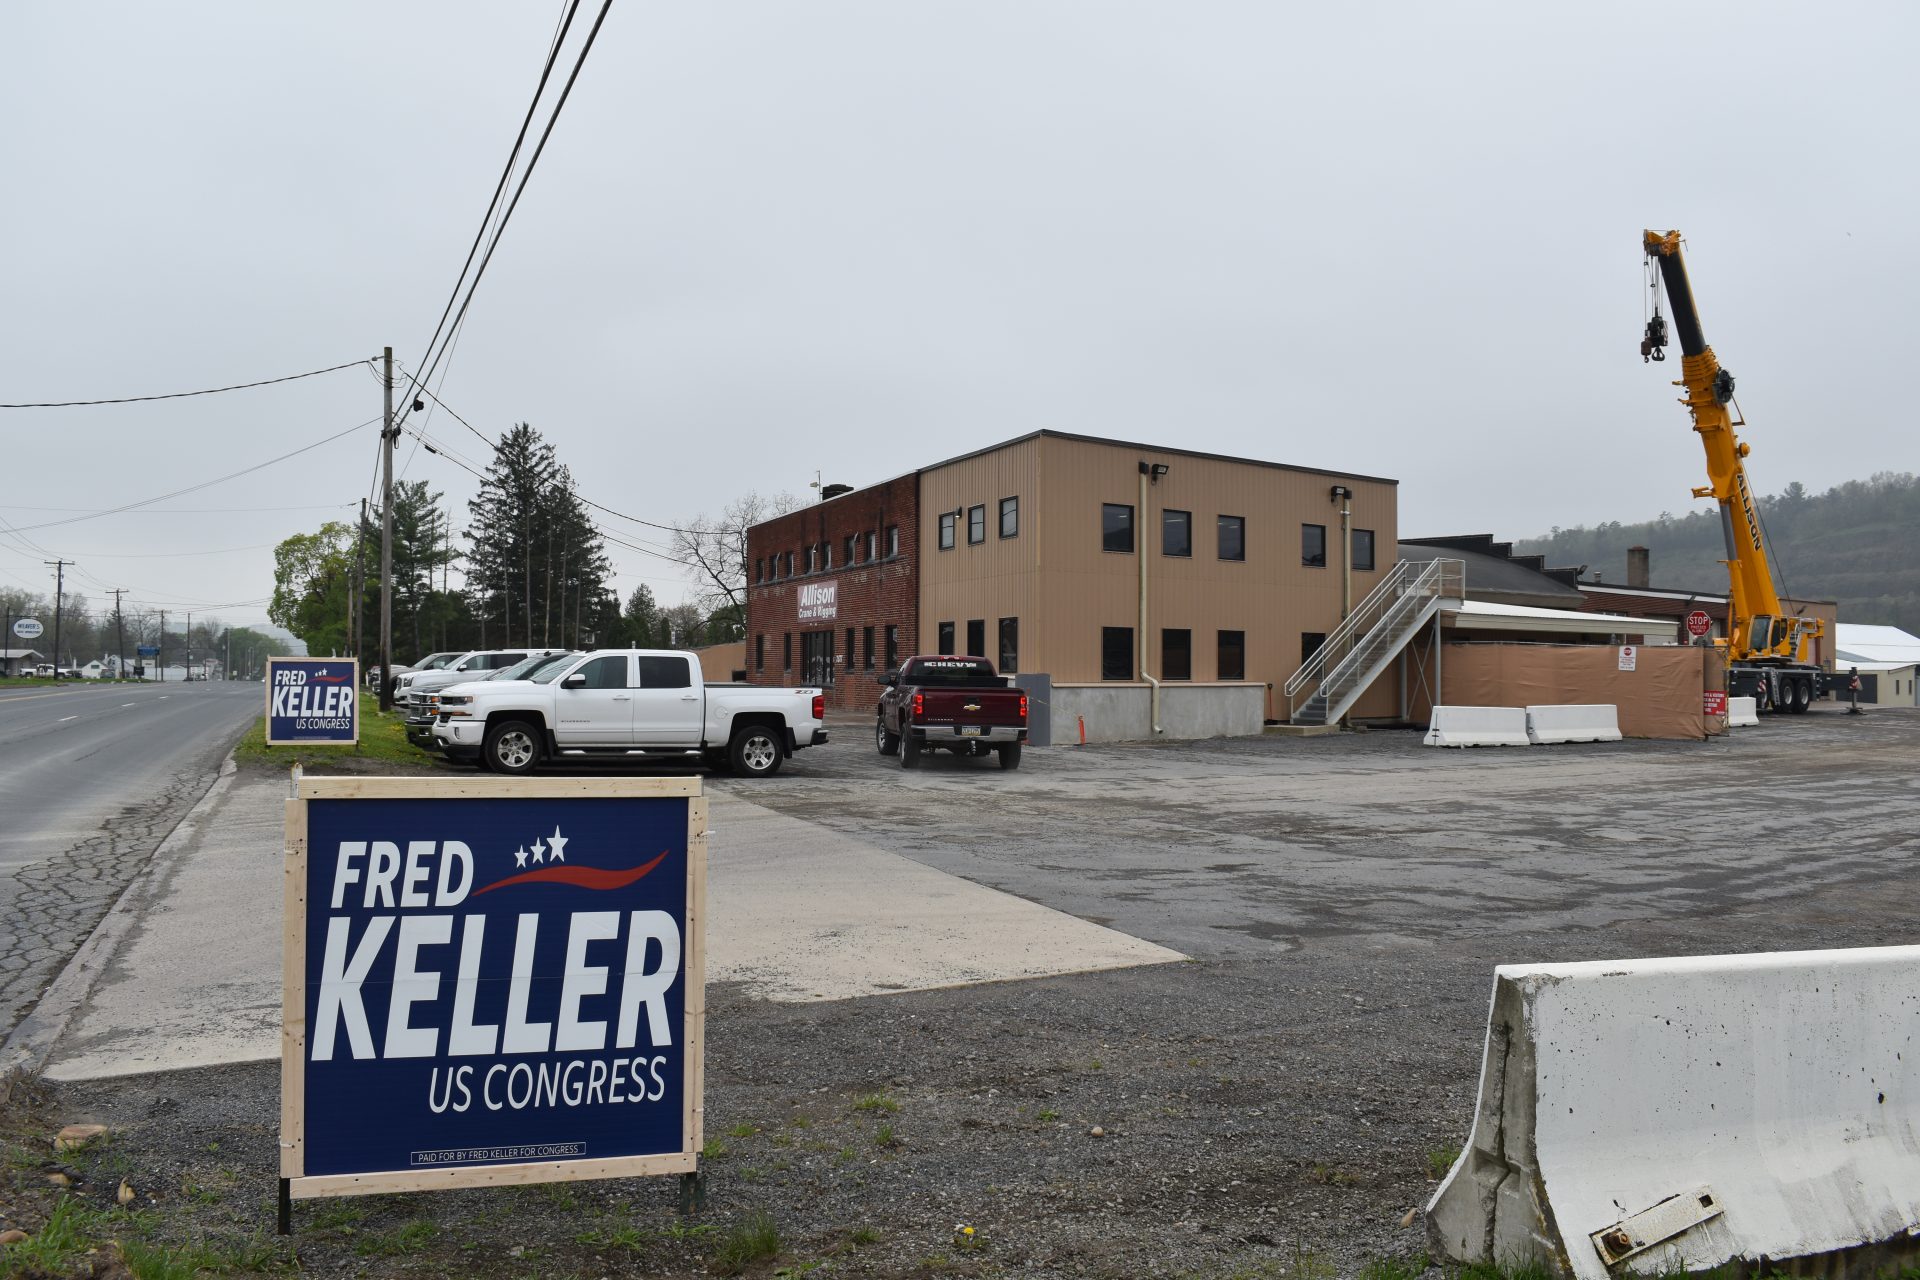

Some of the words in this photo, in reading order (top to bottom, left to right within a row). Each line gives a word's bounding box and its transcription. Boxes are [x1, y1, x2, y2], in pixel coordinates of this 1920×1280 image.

[800, 584, 835, 607] Allison
[798, 609, 812, 618] Crane
[813, 606, 817, 617] &
[818, 605, 836, 619] Rigging
[1689, 616, 1708, 625] STOP
[275, 670, 307, 686] FRED
[271, 686, 354, 718] KELLER
[296, 718, 307, 729] US
[308, 718, 350, 729] CONGRESS
[330, 840, 474, 909] FRED
[311, 910, 681, 1061] KELLER
[429, 1065, 474, 1113] US
[484, 1056, 667, 1110] CONGRESS
[418, 1153, 437, 1162] PAID
[438, 1152, 455, 1161] FOR
[456, 1151, 467, 1160] BY
[468, 1150, 489, 1159] FRED
[490, 1149, 518, 1158] KELLER
[520, 1147, 536, 1156] FOR
[537, 1144, 579, 1155] CONGRESS
